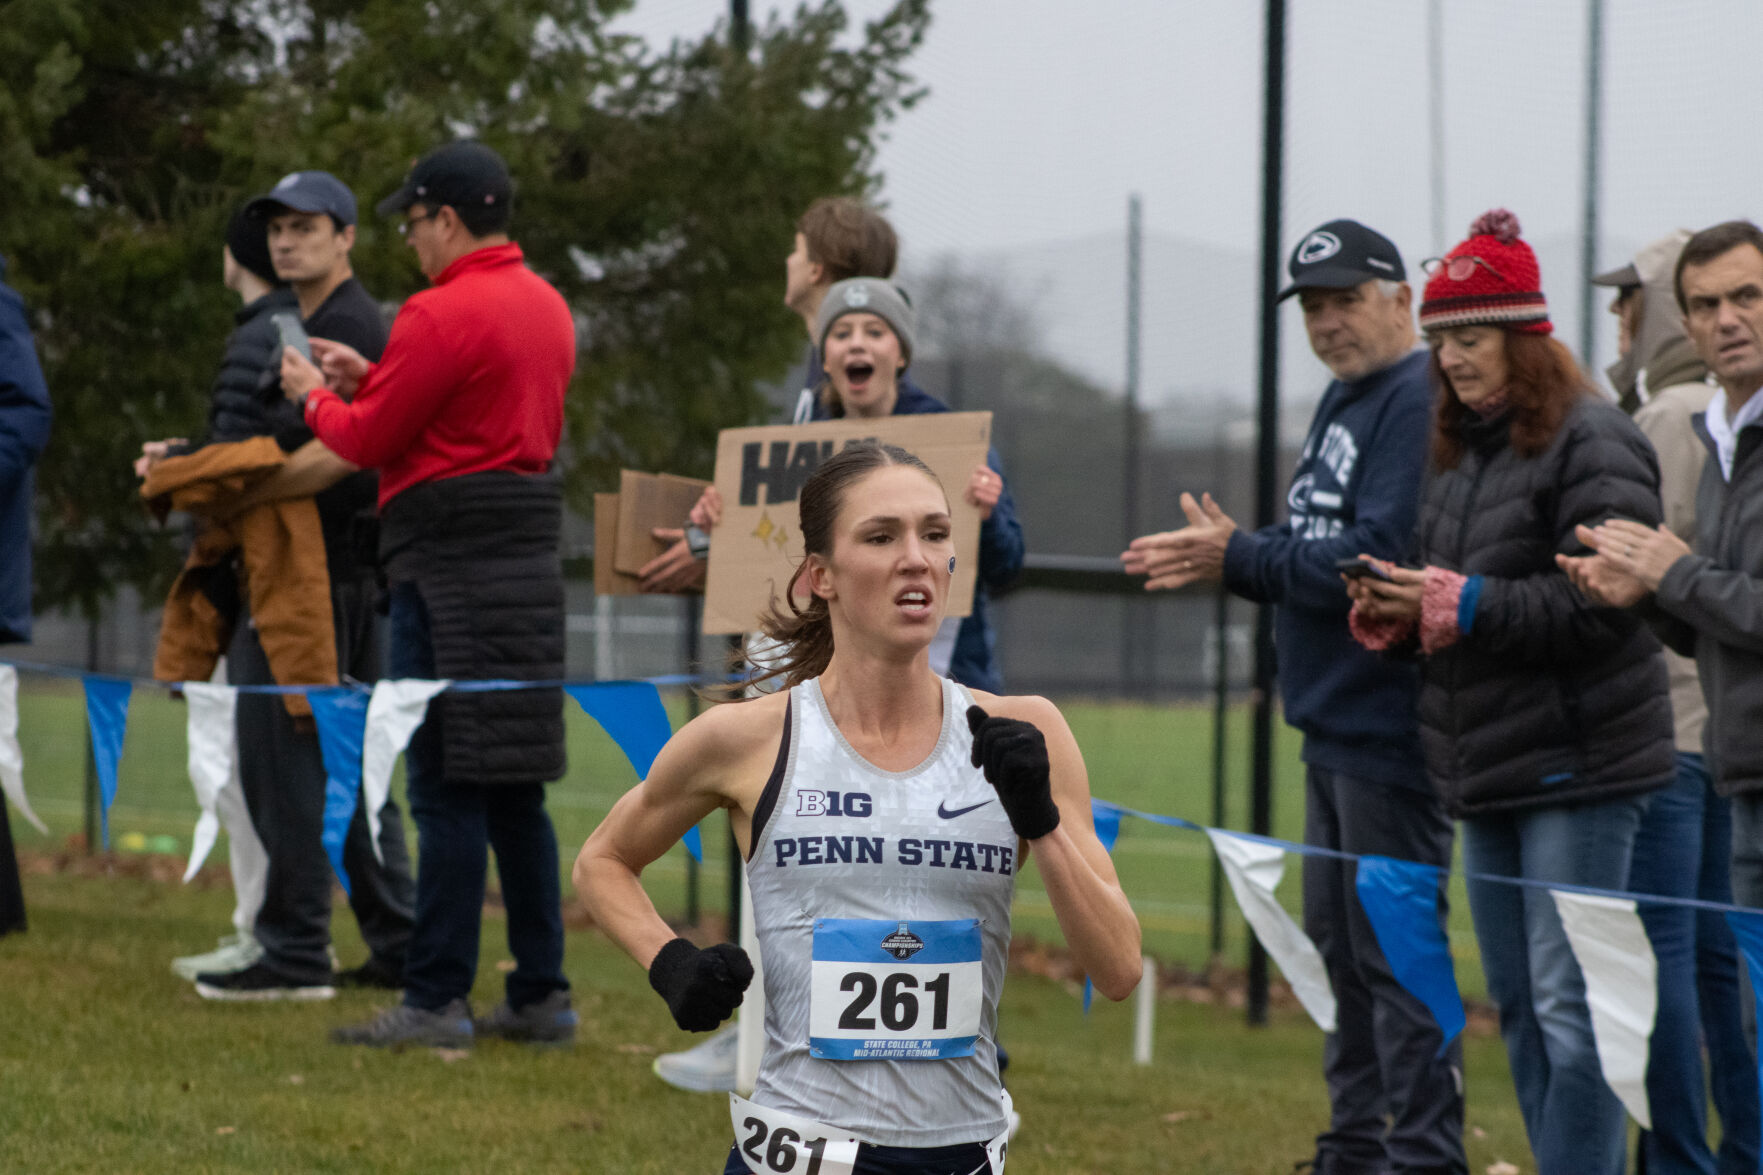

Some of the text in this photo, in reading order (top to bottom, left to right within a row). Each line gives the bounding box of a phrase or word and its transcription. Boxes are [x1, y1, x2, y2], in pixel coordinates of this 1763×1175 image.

[774, 836, 1013, 876] PENN STATE
[838, 971, 950, 1031] 261
[853, 1049, 940, 1057] MID-ATLANTIC REGIONAL
[863, 1040, 932, 1049] STATE COLLEGE, PA
[743, 1116, 828, 1175] 261
